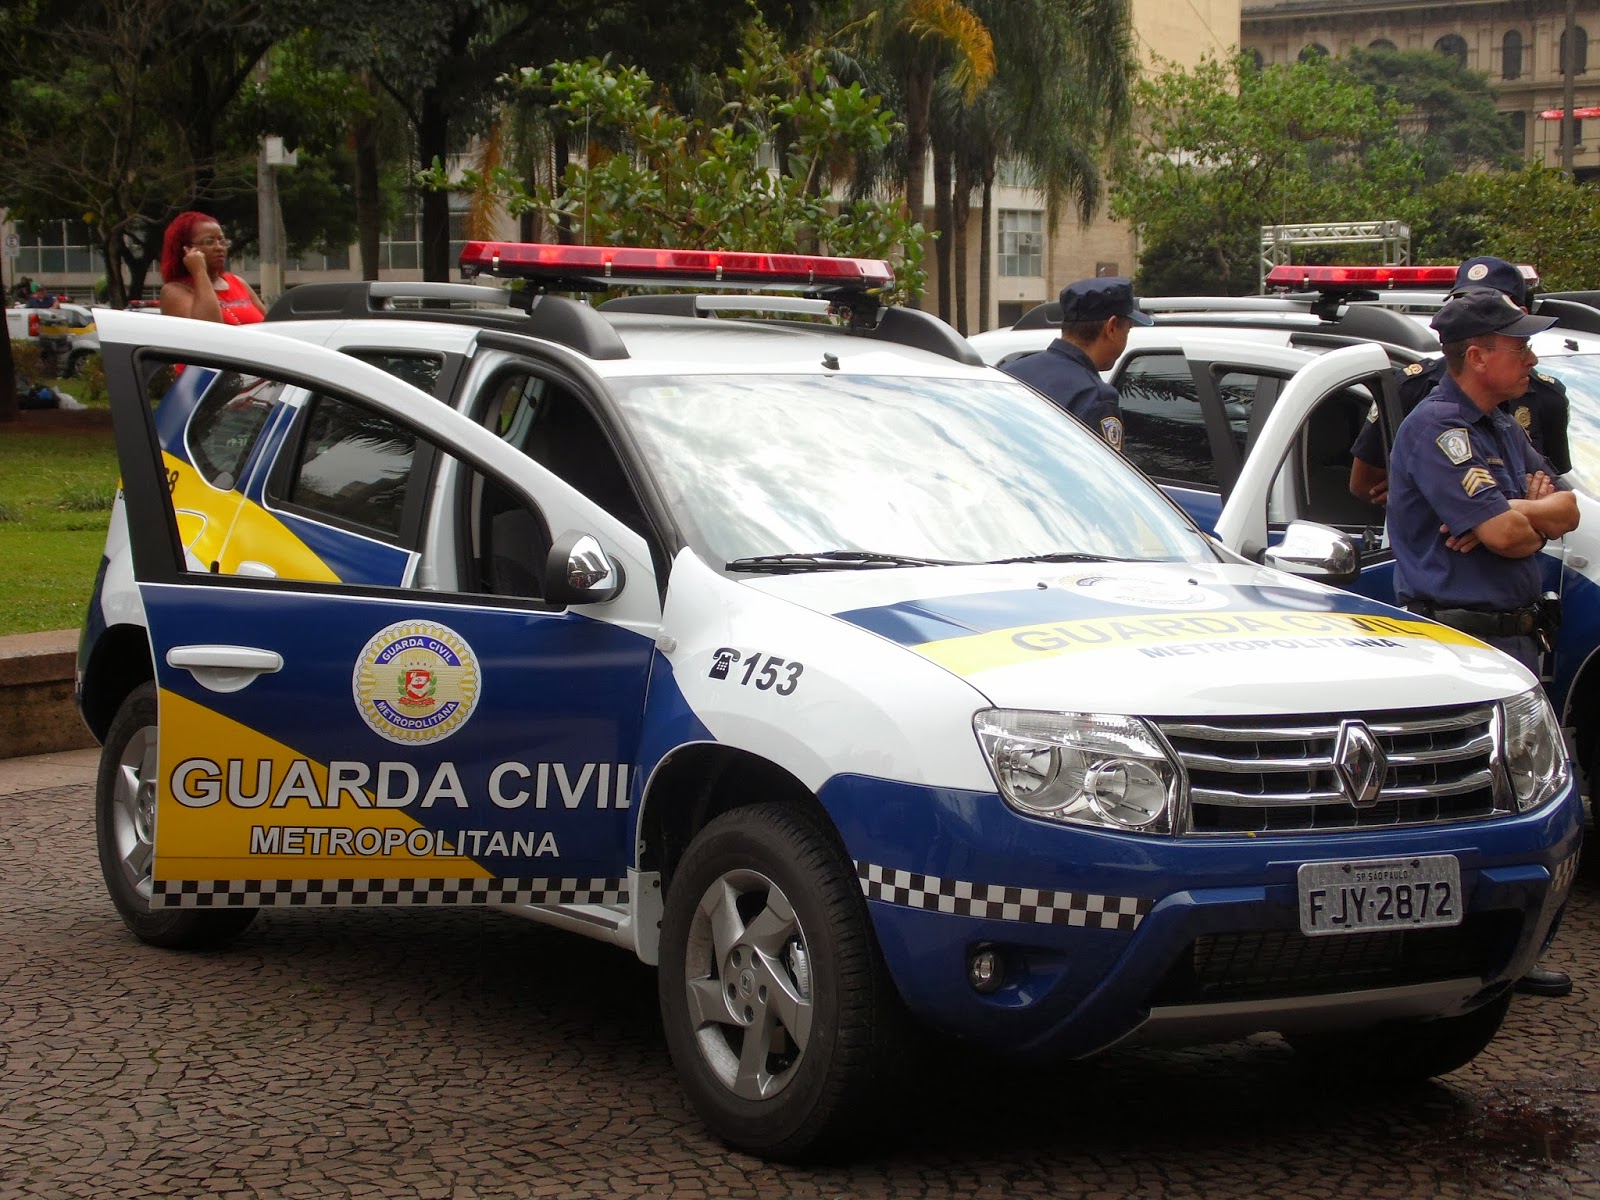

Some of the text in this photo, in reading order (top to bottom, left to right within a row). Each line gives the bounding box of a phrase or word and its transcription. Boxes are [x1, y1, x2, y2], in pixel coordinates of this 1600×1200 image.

[1012, 613, 1425, 652] GUARDA CIVIL
[382, 638, 452, 662] GUARDA CIVIL
[1136, 637, 1407, 659] METROPOLITANA
[741, 652, 804, 696] 153
[377, 701, 456, 728] METROPOLITANA
[170, 757, 630, 810] GUARDA CIVIL
[250, 826, 559, 858] METROPOLITANA
[1384, 870, 1408, 880] PAULO
